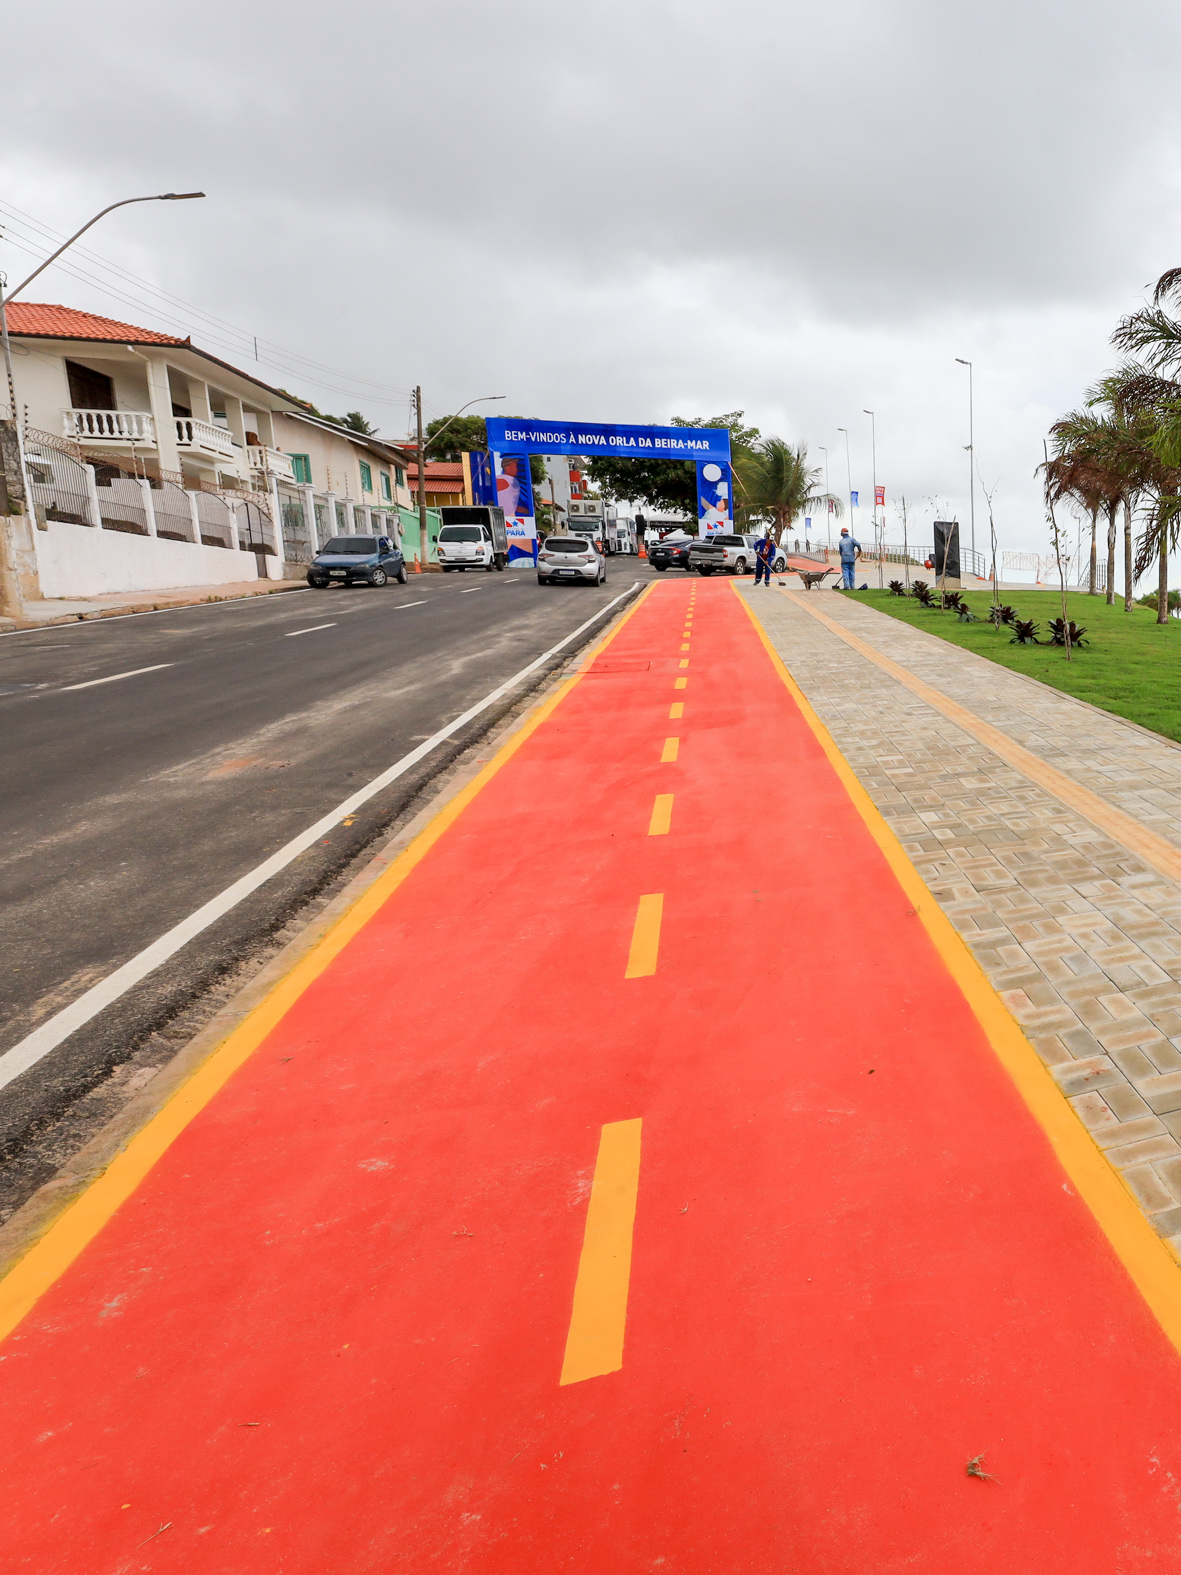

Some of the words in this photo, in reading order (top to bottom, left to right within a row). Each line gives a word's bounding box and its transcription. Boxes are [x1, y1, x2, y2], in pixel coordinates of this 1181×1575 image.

[504, 430, 567, 443] BEM-VINDOS
[568, 431, 577, 444] À
[578, 434, 607, 445] NOVA
[608, 435, 637, 447] ORLA
[638, 437, 653, 448] DA
[654, 438, 710, 450] BEIRA-MAR
